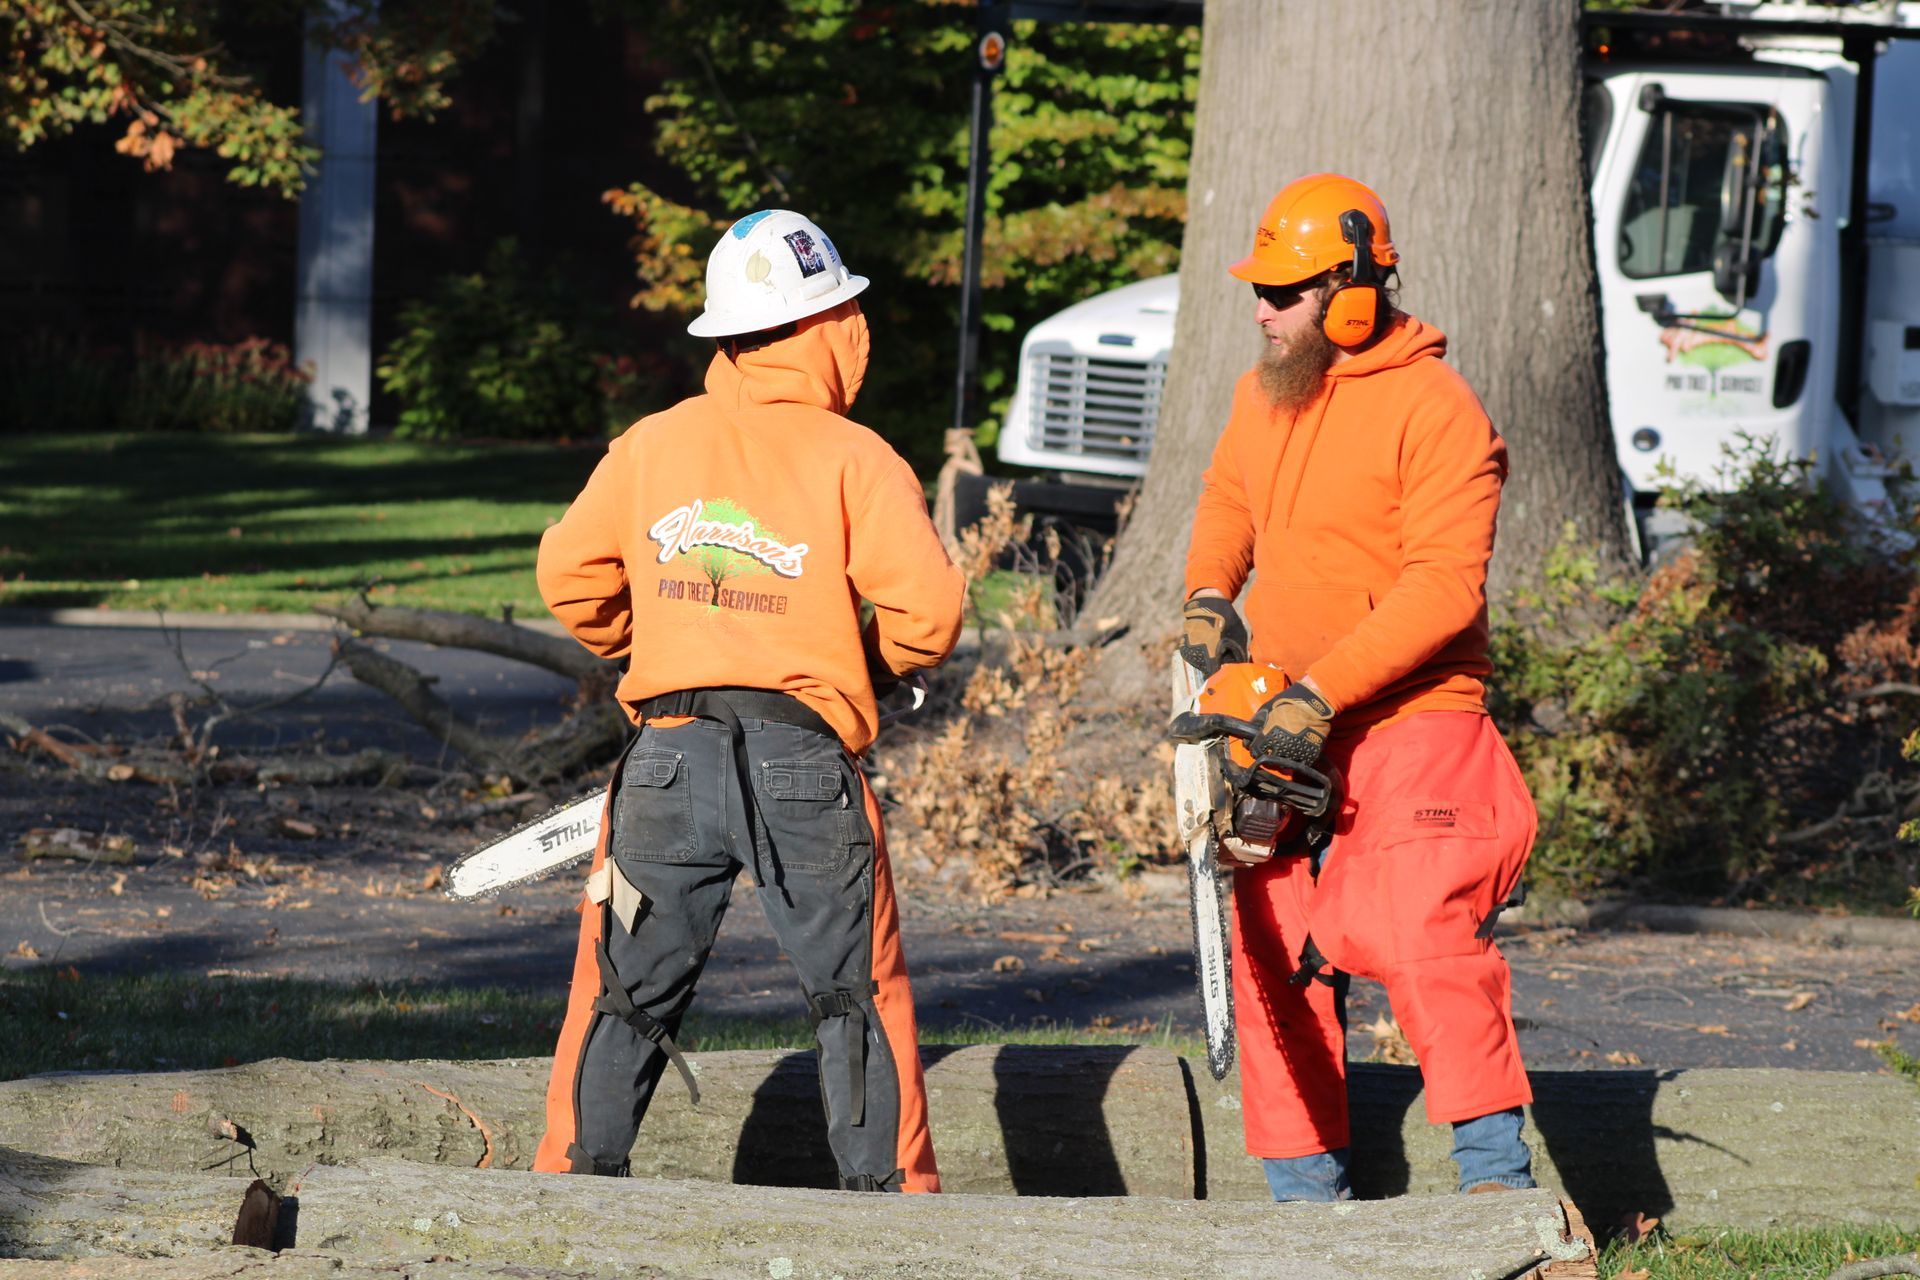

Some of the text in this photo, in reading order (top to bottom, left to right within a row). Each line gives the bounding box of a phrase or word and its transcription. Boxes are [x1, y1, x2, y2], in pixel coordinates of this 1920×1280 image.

[658, 578, 685, 600] PRO
[688, 581, 711, 603] TREE
[720, 588, 777, 614] SERVICE
[541, 818, 596, 853] STIHL
